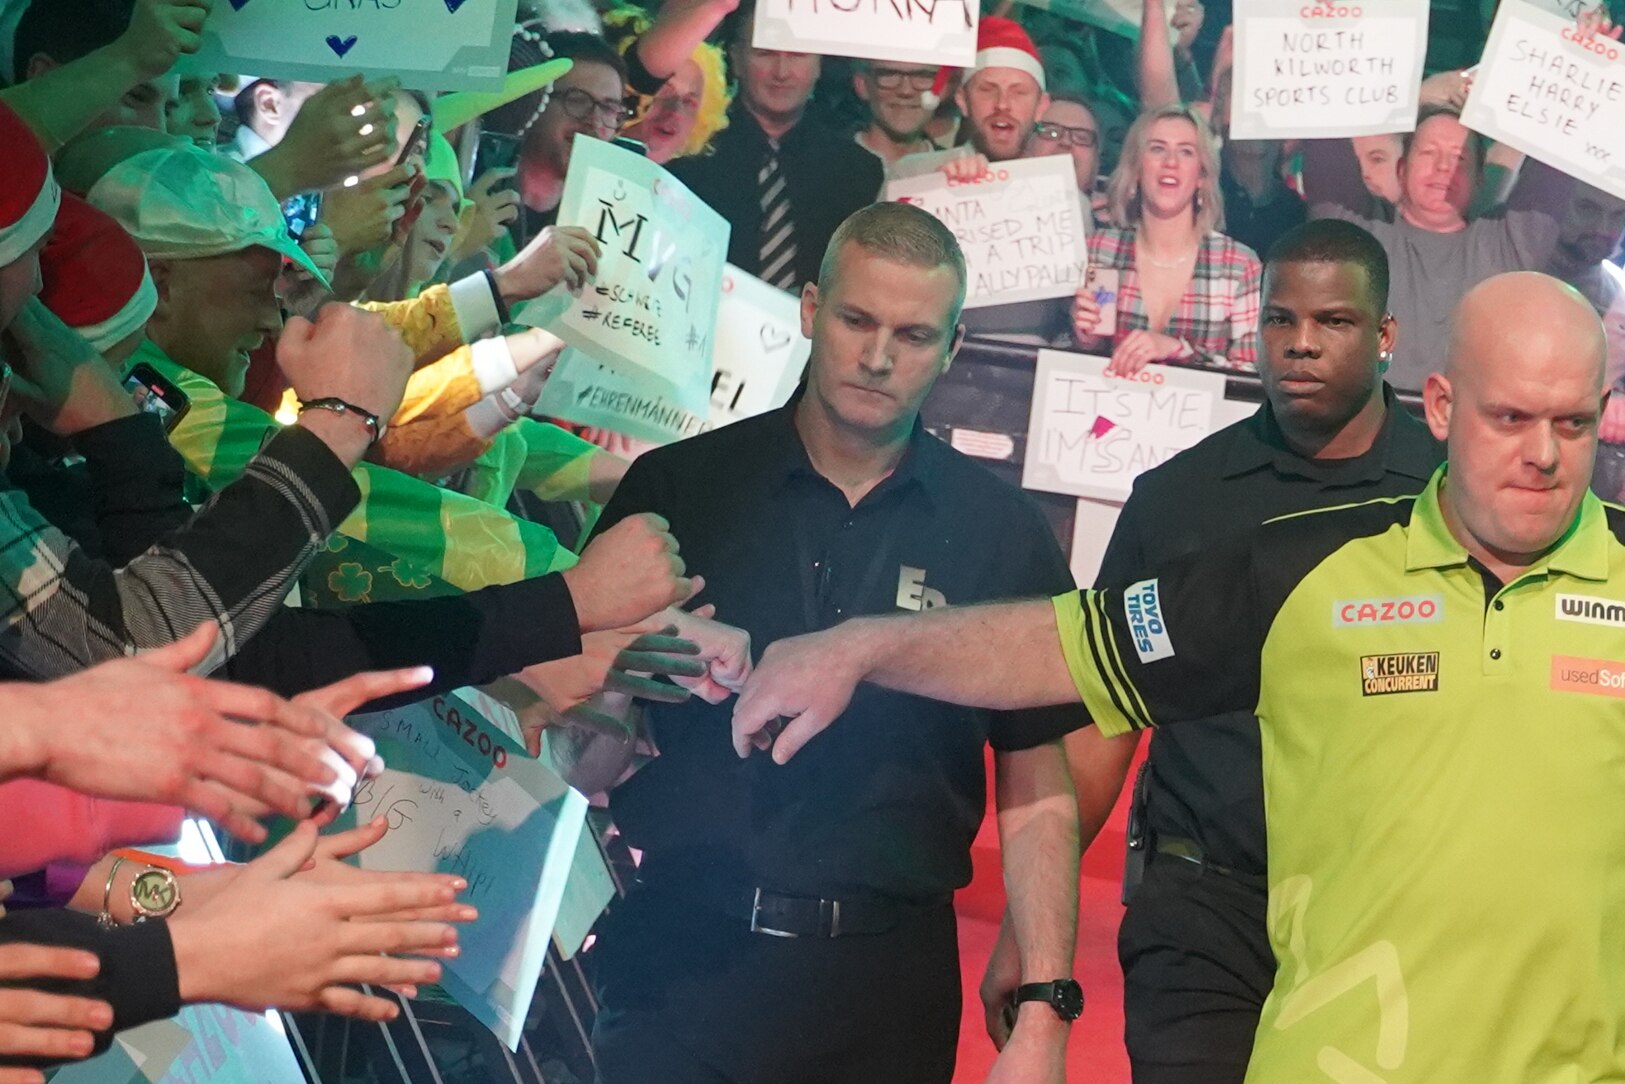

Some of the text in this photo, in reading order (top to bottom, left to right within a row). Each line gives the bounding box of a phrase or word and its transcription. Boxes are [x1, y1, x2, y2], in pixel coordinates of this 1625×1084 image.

[1283, 32, 1364, 54] NORTH
[1561, 28, 1619, 60] CAZOO
[1274, 57, 1394, 77] KILWORTH
[1254, 85, 1399, 108] SPORTS CLUB
[1530, 76, 1600, 120] HARRY
[1506, 94, 1578, 136] ELSIE
[1014, 231, 1075, 260] TRIP
[896, 564, 948, 611] EP
[1127, 593, 1155, 653] TIRES
[1142, 583, 1163, 635] TOYO
[1340, 600, 1437, 624] CAZOO
[1376, 653, 1437, 677] KEUKEN
[1364, 674, 1437, 694] CONCURRENT
[432, 697, 508, 769] CAZOO
